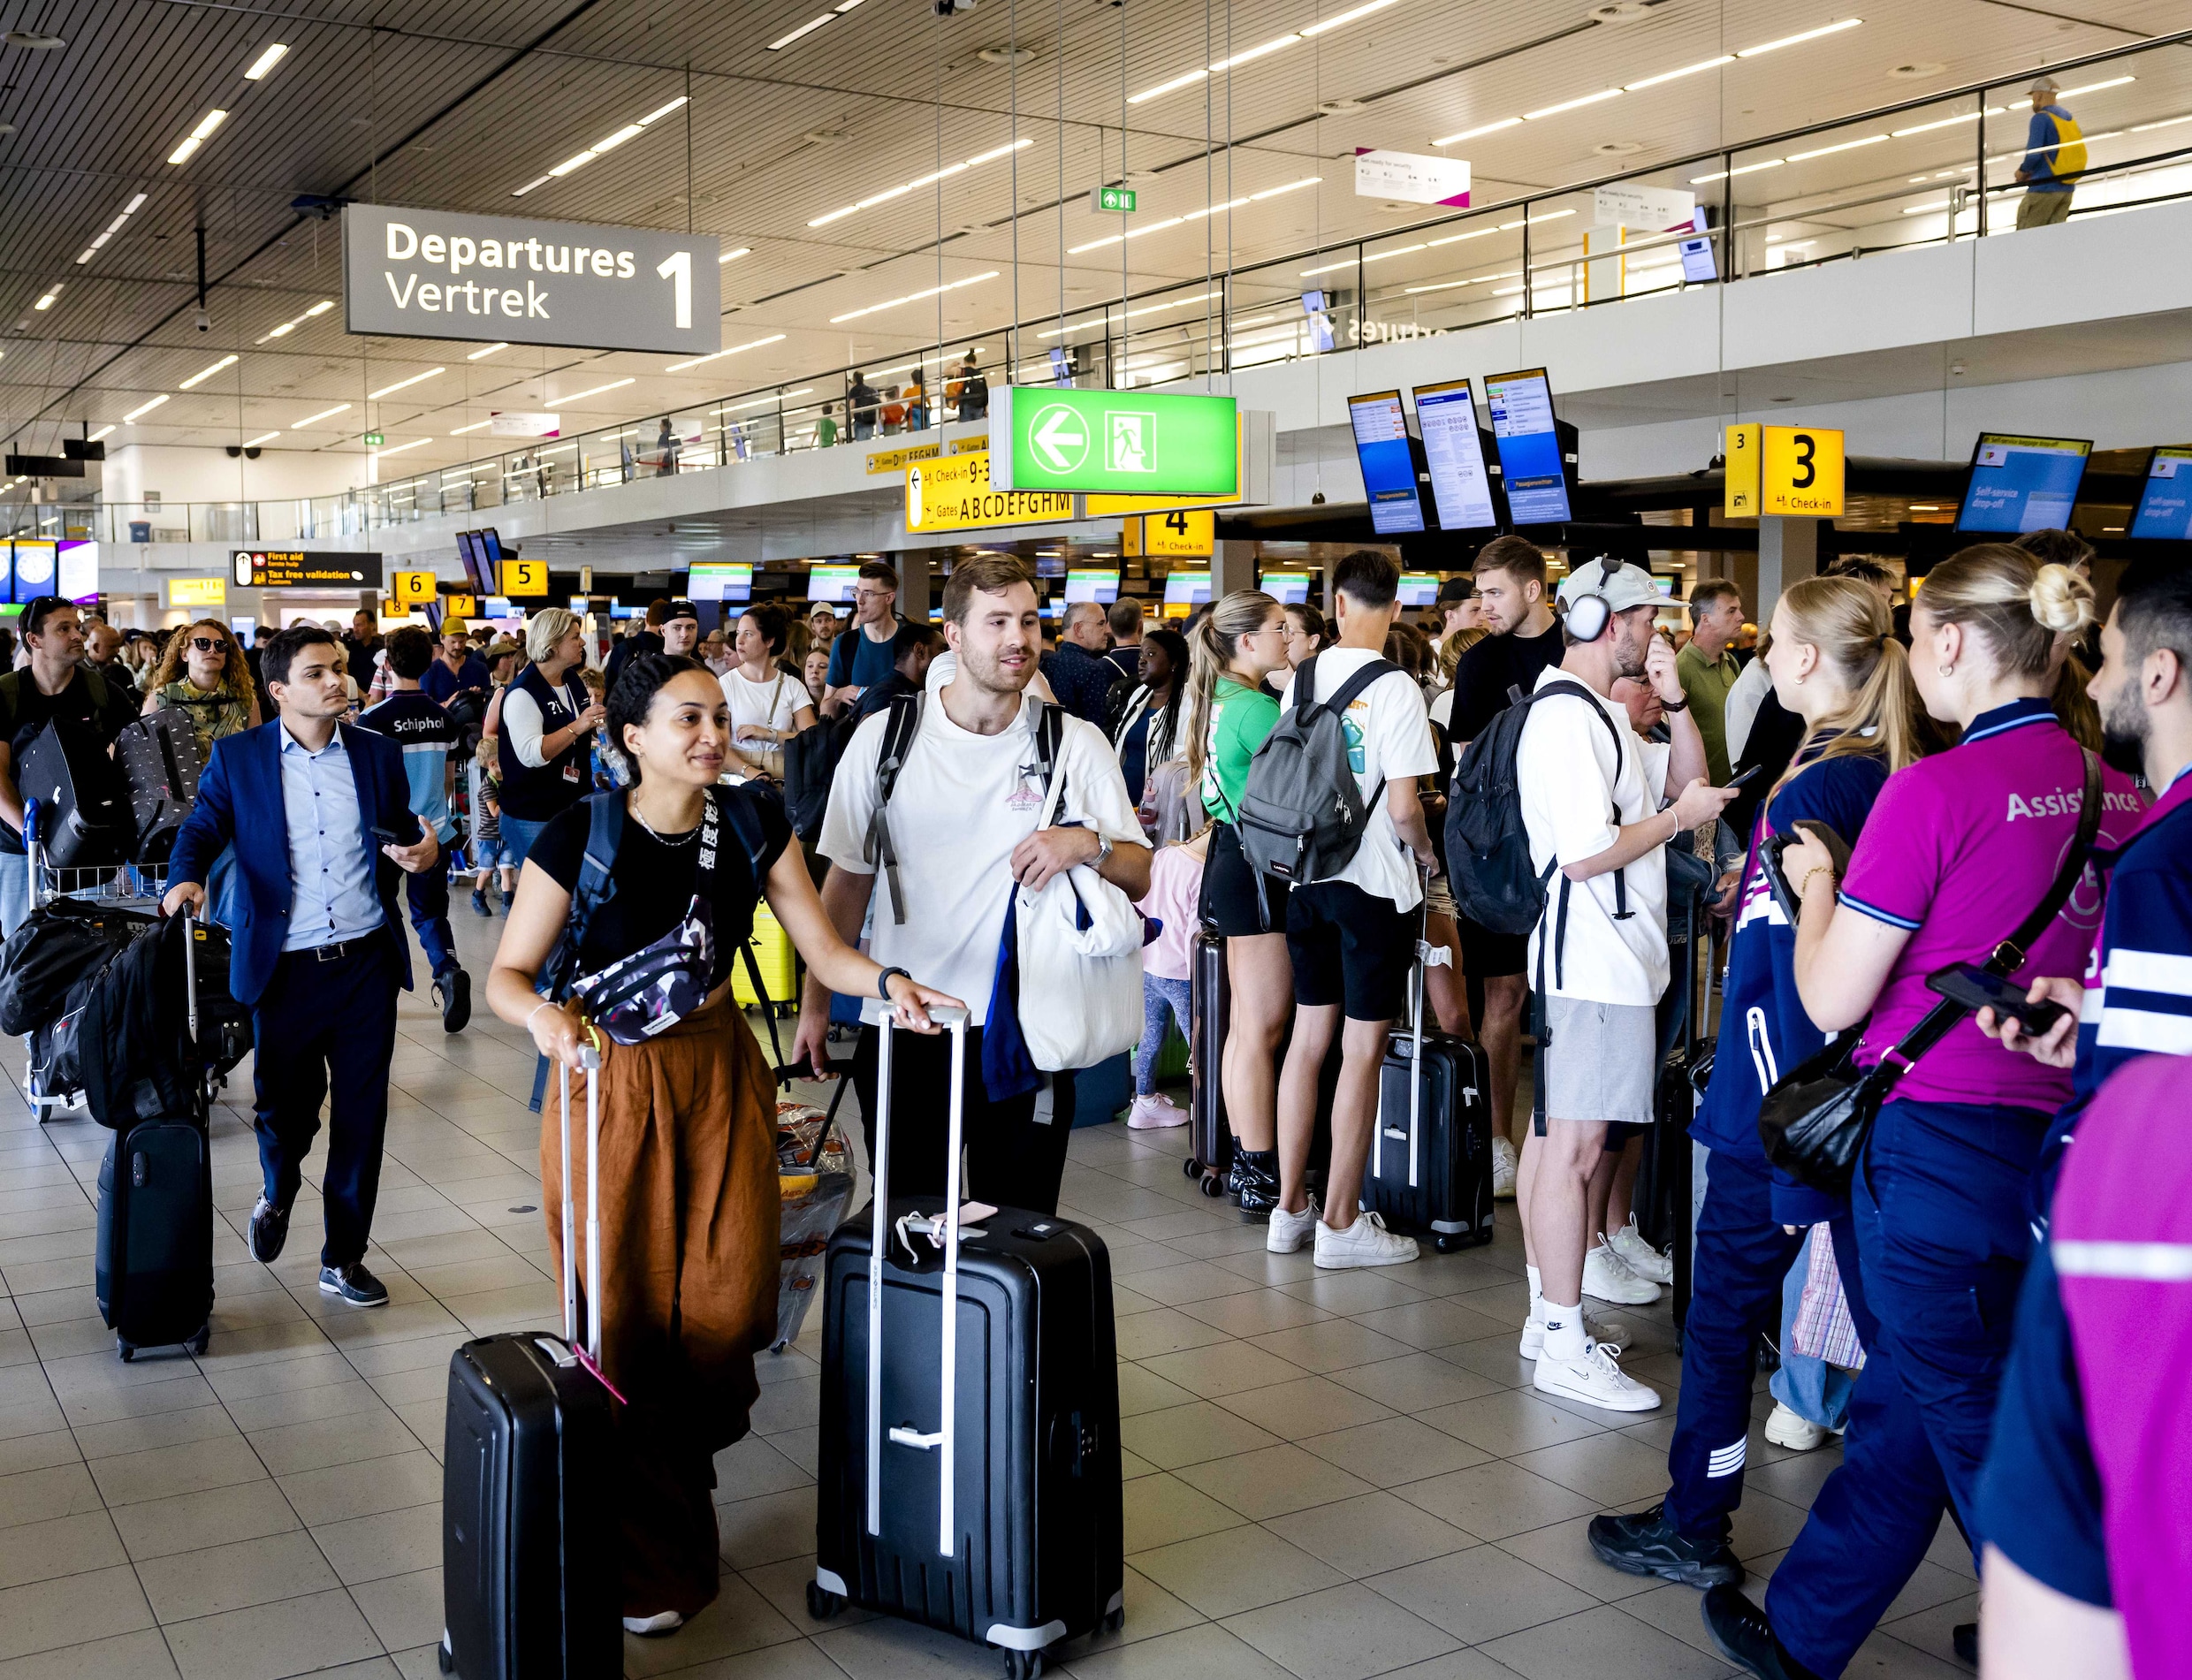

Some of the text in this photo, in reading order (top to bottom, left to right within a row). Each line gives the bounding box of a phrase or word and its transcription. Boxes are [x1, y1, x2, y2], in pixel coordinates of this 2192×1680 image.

[386, 223, 636, 278] Departures
[384, 271, 551, 319] Vertrek
[656, 251, 692, 329] 1
[1737, 433, 1745, 449] 3
[1792, 434, 1815, 489] 3
[936, 467, 968, 483] Check-in
[1791, 497, 1831, 509] Check-in
[937, 505, 958, 518] Gates
[1165, 511, 1189, 536] 4
[1169, 542, 1204, 551] Check-in
[268, 552, 303, 561] First aid
[268, 570, 350, 579] Tax free validation
[519, 564, 530, 584] 5
[410, 574, 422, 593] 6
[394, 602, 401, 612] 8
[458, 597, 466, 610] 7
[393, 716, 445, 733] Schiphol
[2006, 787, 2140, 822] Assisnce
